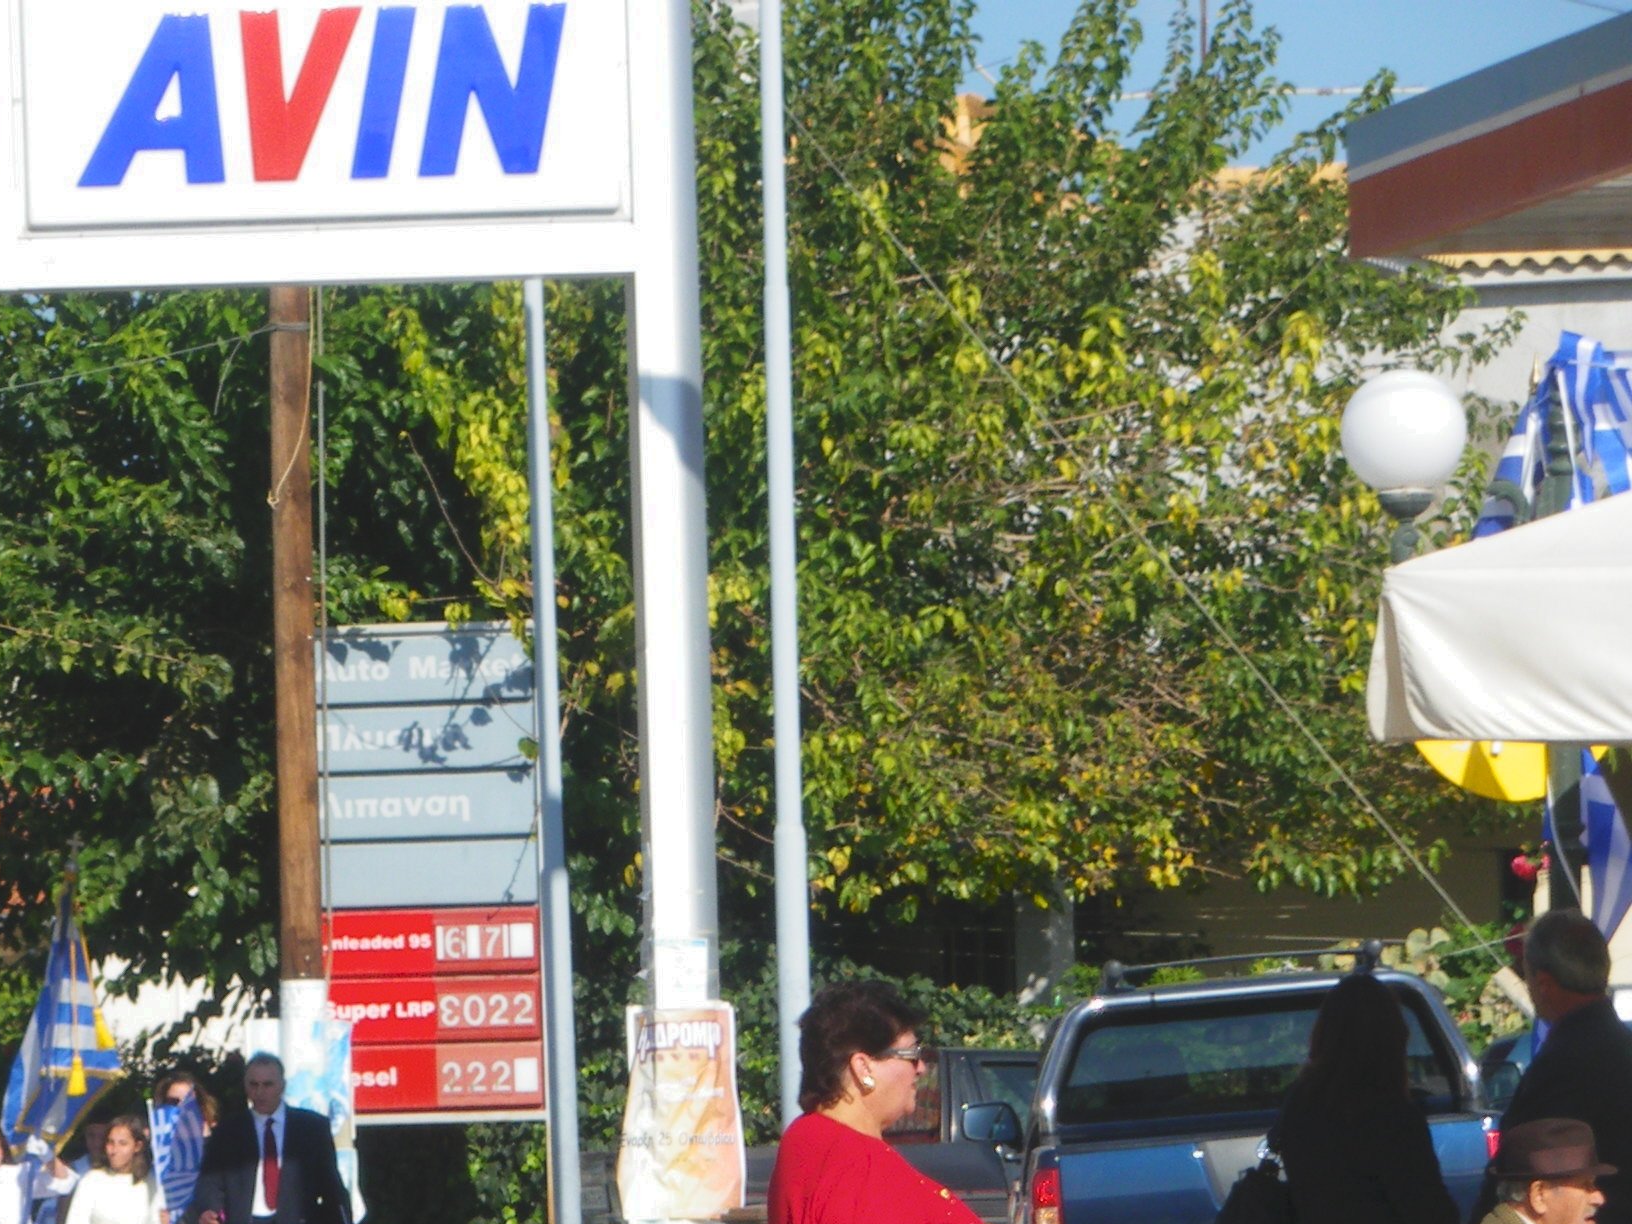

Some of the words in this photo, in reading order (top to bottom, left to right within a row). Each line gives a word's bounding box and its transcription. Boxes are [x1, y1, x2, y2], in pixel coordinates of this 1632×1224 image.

[77, 3, 565, 188] AVIN
[316, 657, 390, 682] Auto
[408, 652, 523, 680] Maket
[323, 934, 405, 951] nleaded
[408, 933, 432, 949] 95
[325, 1001, 390, 1024] Super
[396, 1001, 435, 1019] LRP
